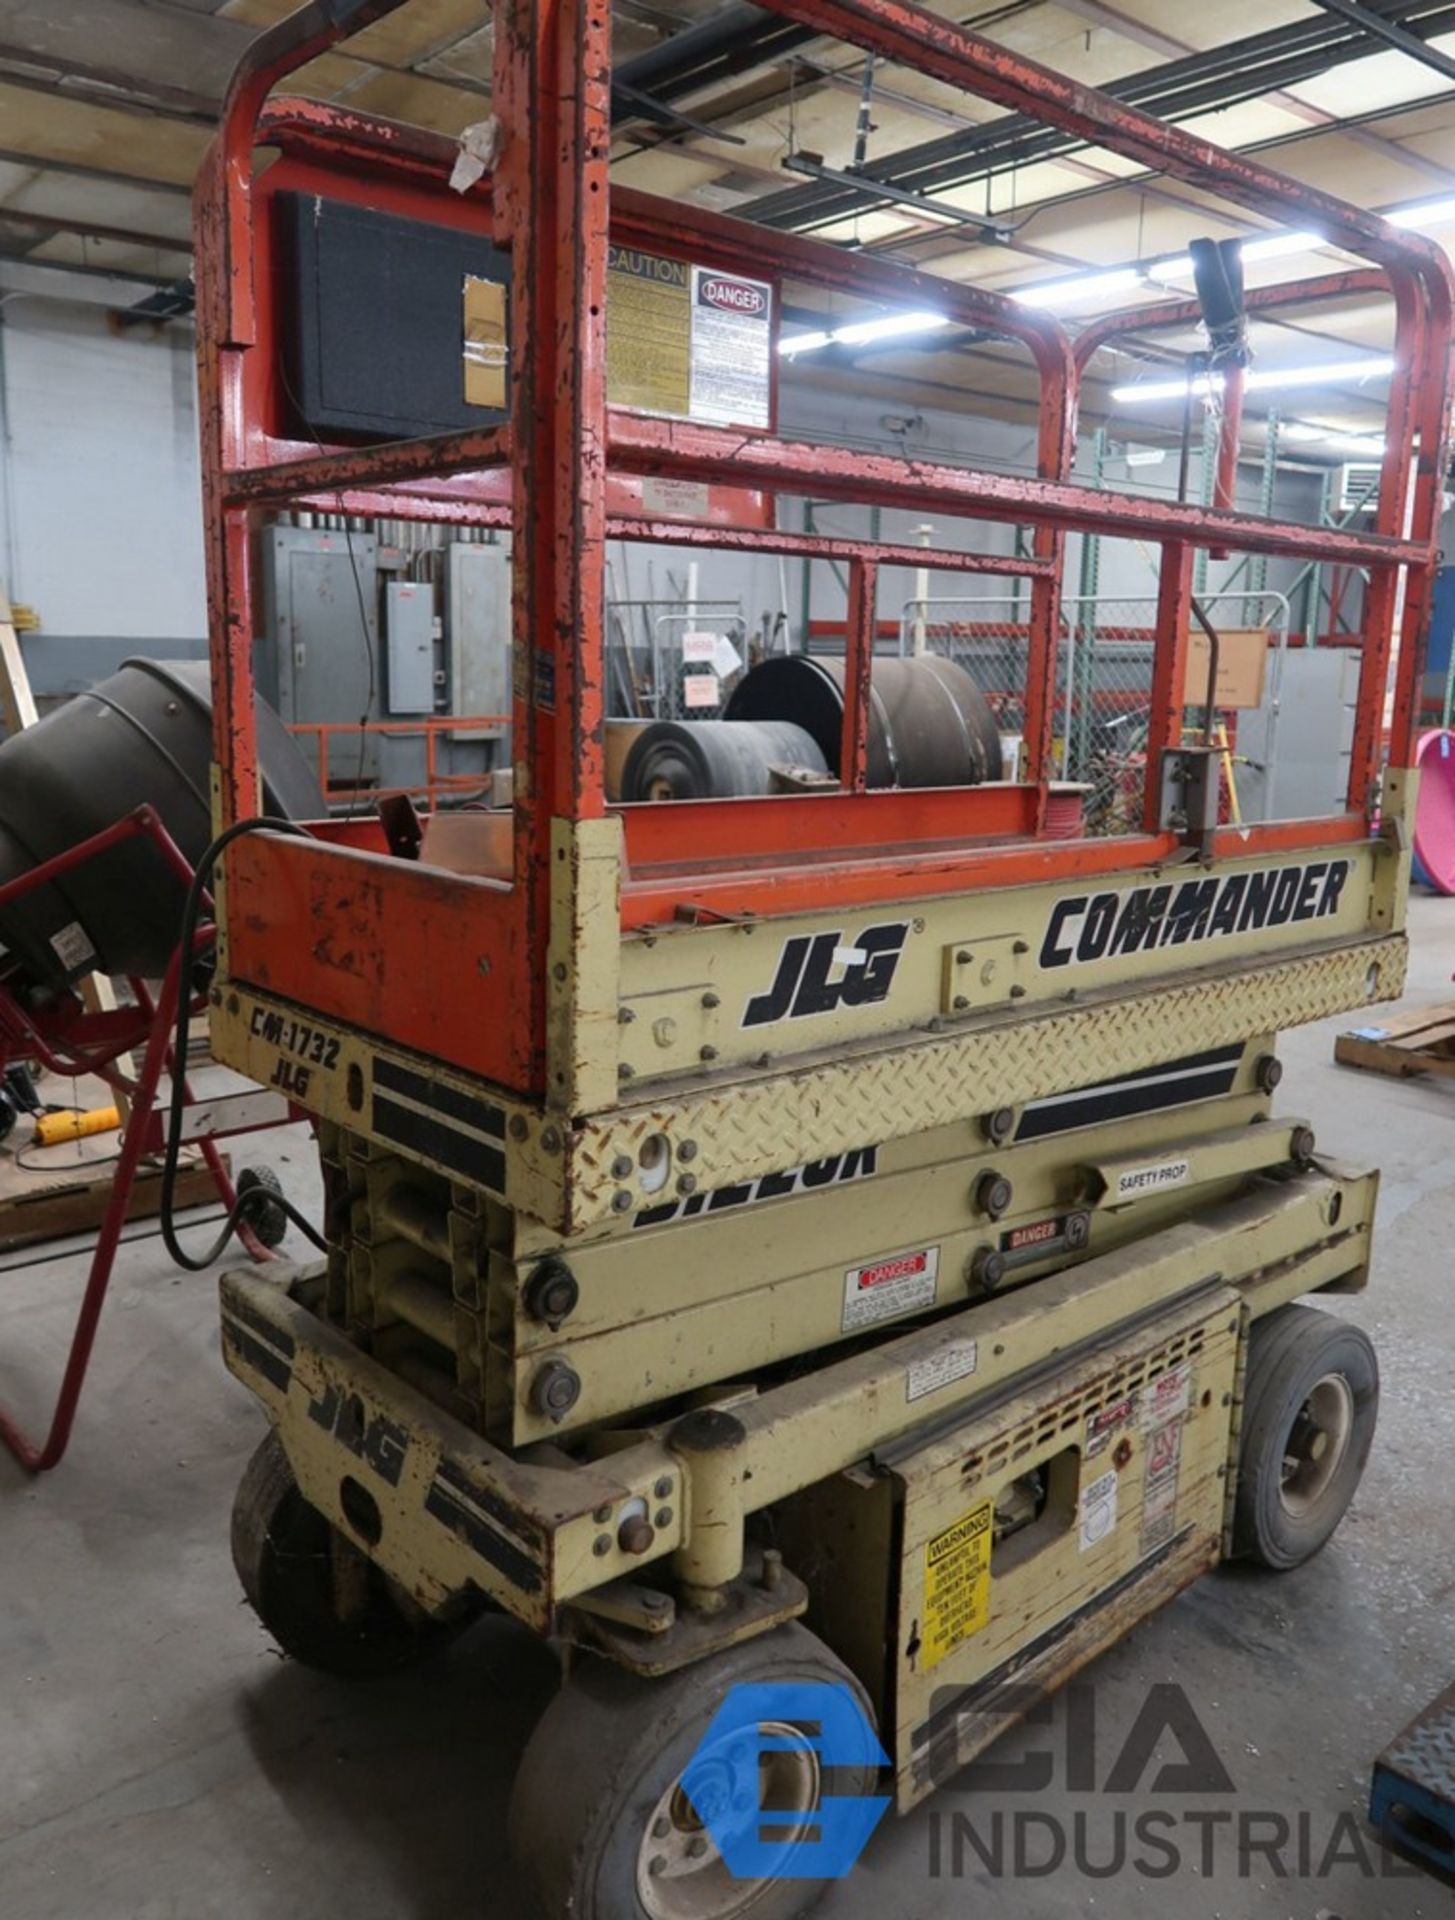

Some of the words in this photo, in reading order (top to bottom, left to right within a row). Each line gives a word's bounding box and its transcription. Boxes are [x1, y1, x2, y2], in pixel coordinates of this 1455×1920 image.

[607, 246, 686, 285] CAUTION
[706, 283, 760, 311] DANGER
[1038, 860, 1349, 969] COMMANDER
[741, 922, 911, 1027] JLG
[270, 1058, 311, 1098] JLG
[1120, 1171, 1160, 1191] SAFETY
[1160, 1164, 1186, 1182] PROP
[1011, 1221, 1057, 1247] DANGER
[868, 1256, 918, 1284] DANGER
[307, 1384, 409, 1488] JLG
[931, 1511, 989, 1558] WARNING
